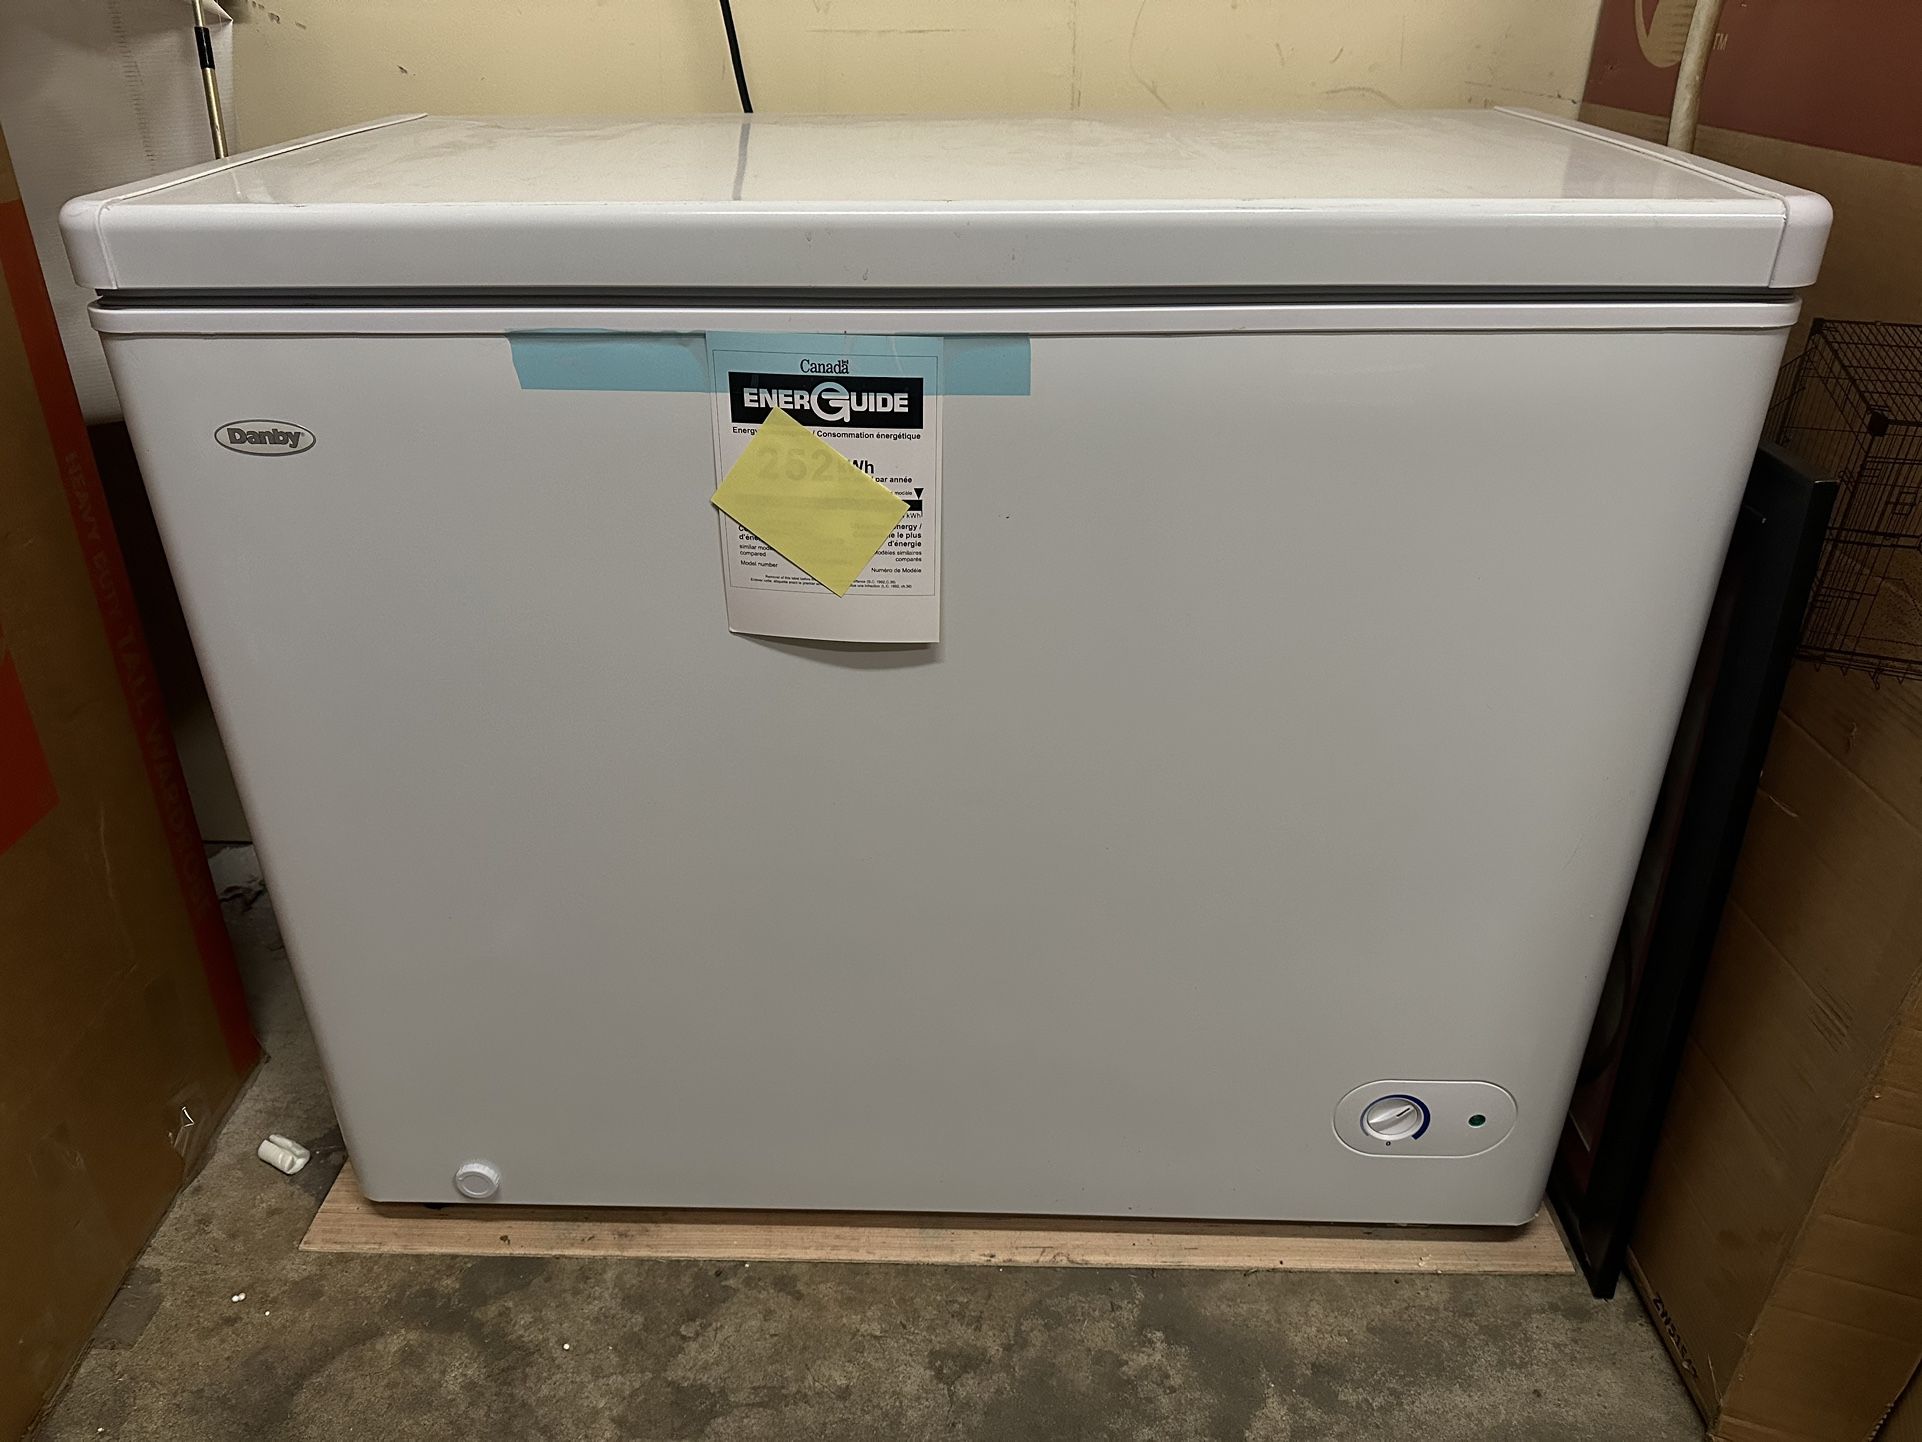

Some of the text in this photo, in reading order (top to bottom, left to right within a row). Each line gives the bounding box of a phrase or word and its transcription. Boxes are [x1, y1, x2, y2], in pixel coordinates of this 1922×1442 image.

[1713, 33, 1728, 50] TM
[800, 359, 849, 374] Canada
[743, 381, 909, 423] ENERGUIDE
[227, 428, 301, 449] Danby
[816, 431, 874, 439] Consommation
[876, 432, 921, 441] énergétique
[889, 475, 912, 483] année
[887, 540, 922, 549] d'énergie
